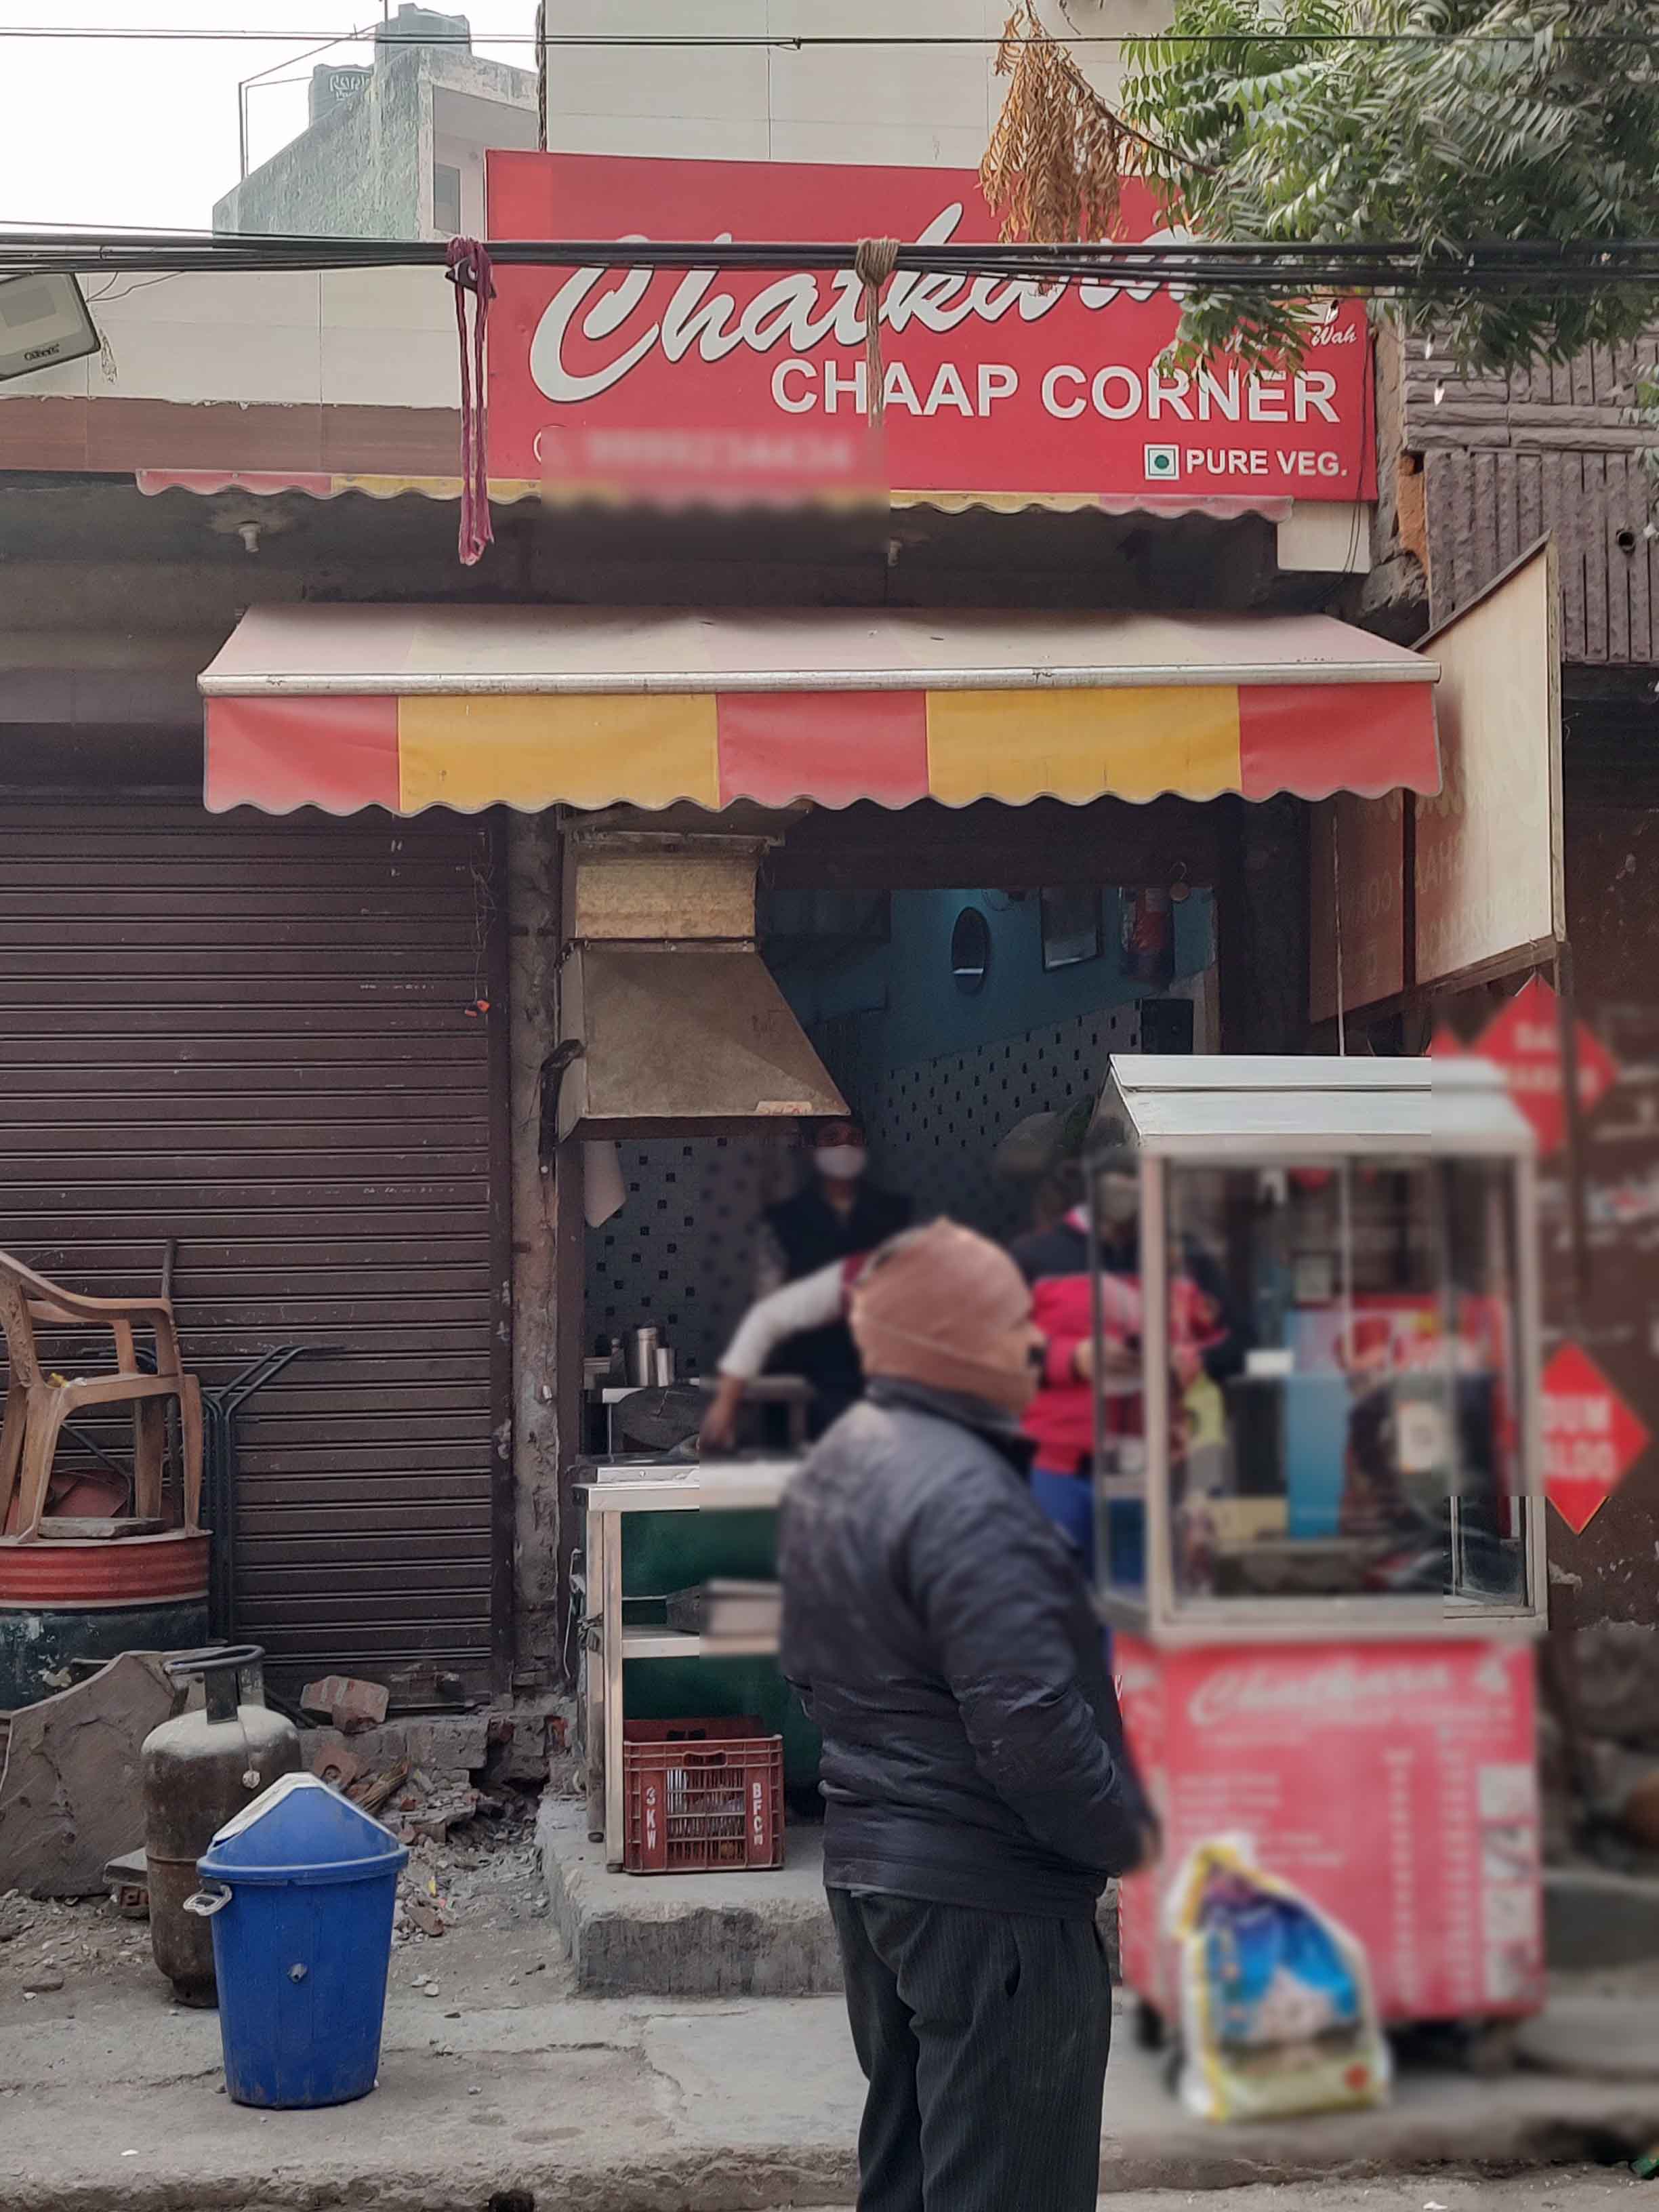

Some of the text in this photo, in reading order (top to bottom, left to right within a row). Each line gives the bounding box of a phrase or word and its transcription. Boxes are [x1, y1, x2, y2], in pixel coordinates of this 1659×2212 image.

[1311, 323, 1357, 347] Wah
[771, 359, 1340, 423] CHAAP CORNER
[1186, 449, 1348, 476] PURE VEG.
